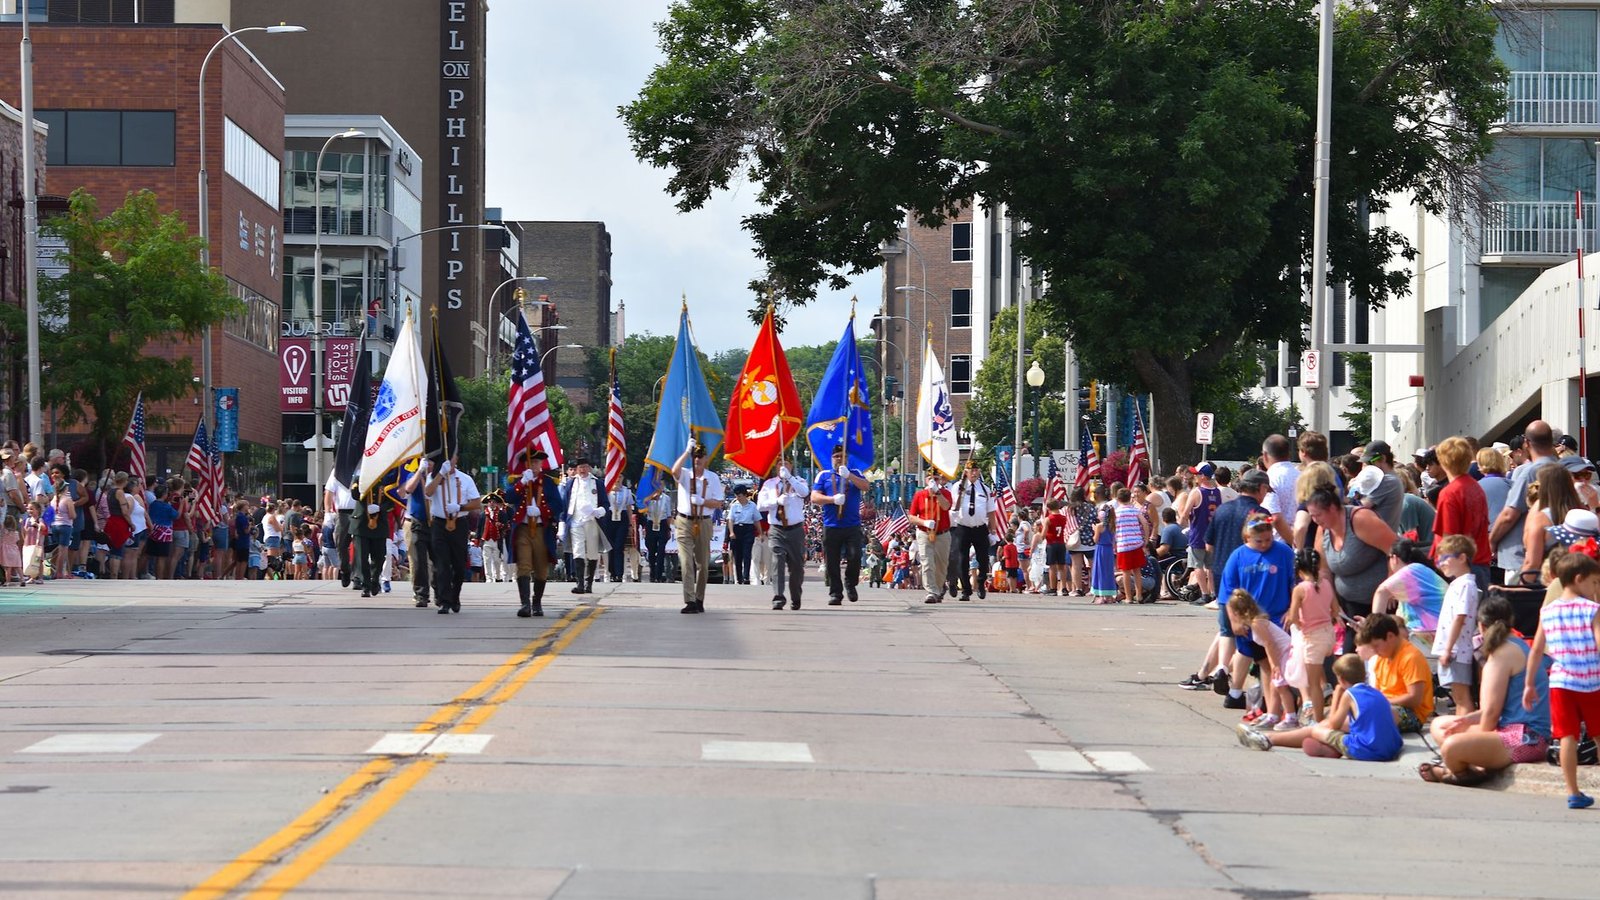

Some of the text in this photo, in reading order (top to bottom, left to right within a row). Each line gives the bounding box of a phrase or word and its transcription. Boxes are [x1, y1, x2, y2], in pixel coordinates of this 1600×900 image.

[443, 62, 470, 77] ON
[446, 89, 466, 309] PHILLIPS
[332, 343, 341, 381] SIOUX
[340, 343, 349, 380] FALLS
[288, 396, 303, 404] INFO
[1055, 526, 1062, 537] 7
